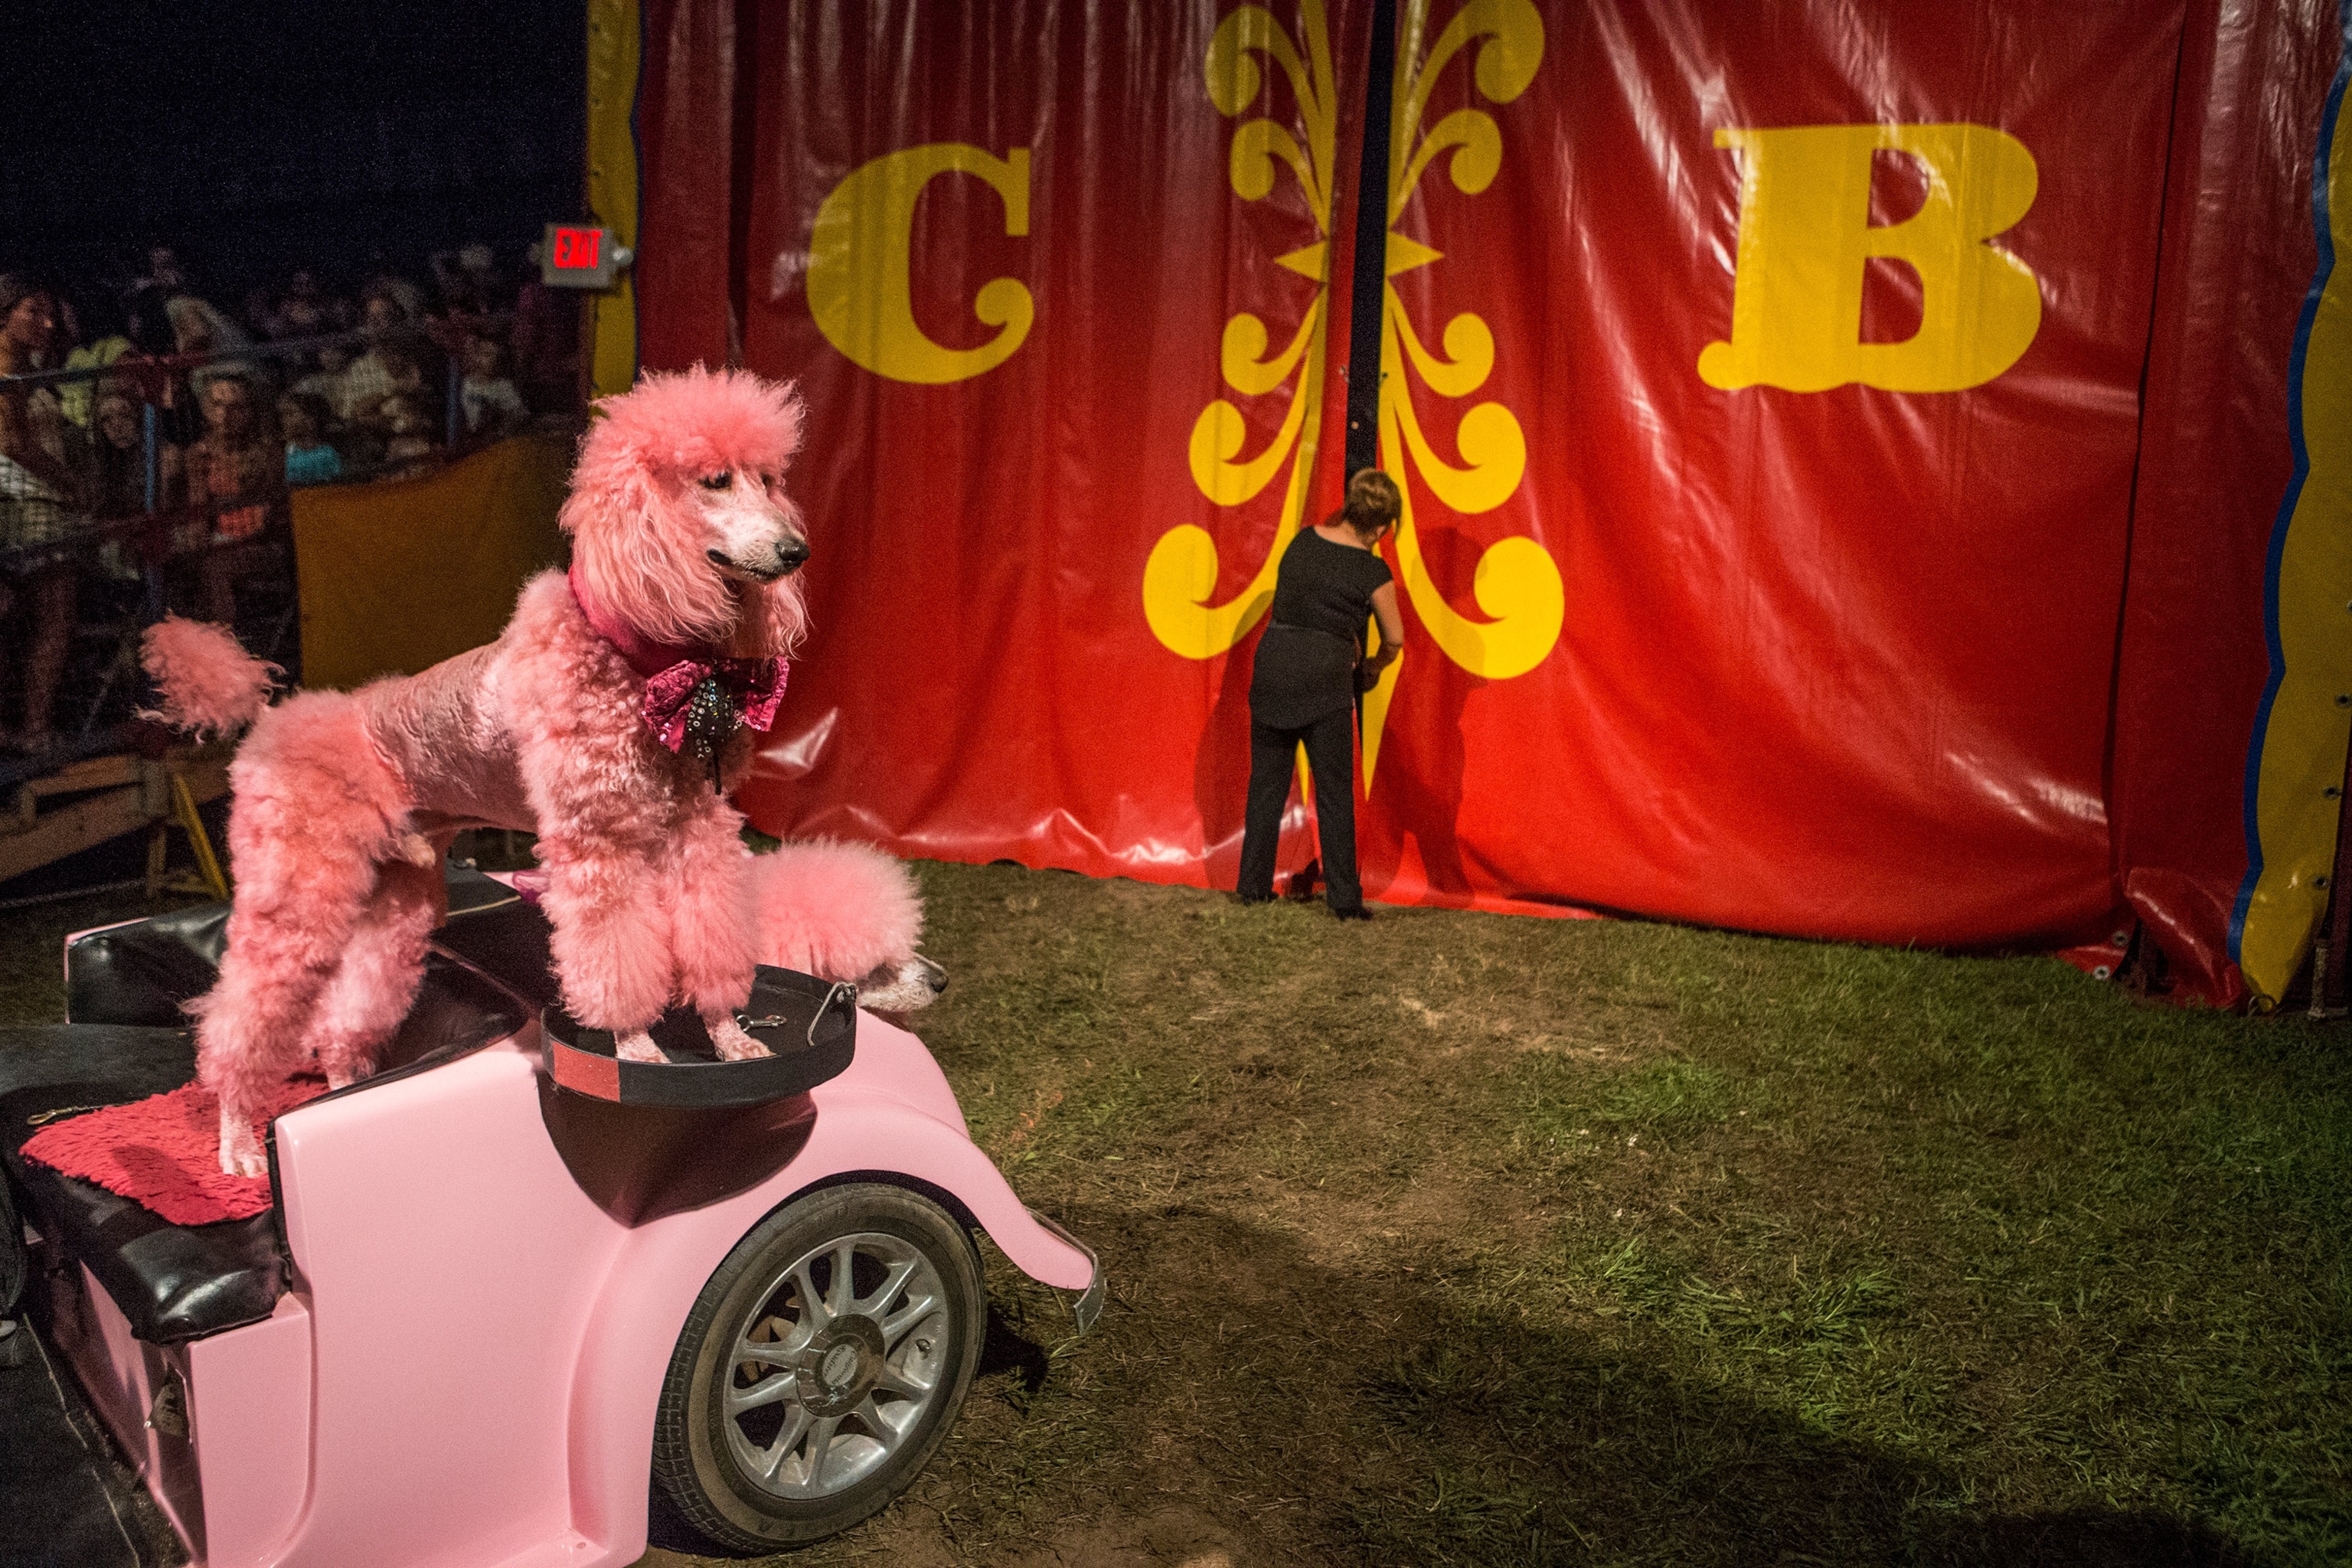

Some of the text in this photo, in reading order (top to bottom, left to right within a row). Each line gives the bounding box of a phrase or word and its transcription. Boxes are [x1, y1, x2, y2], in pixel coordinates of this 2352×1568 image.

[554, 227, 603, 269] EXIT
[806, 122, 2042, 394] C B
